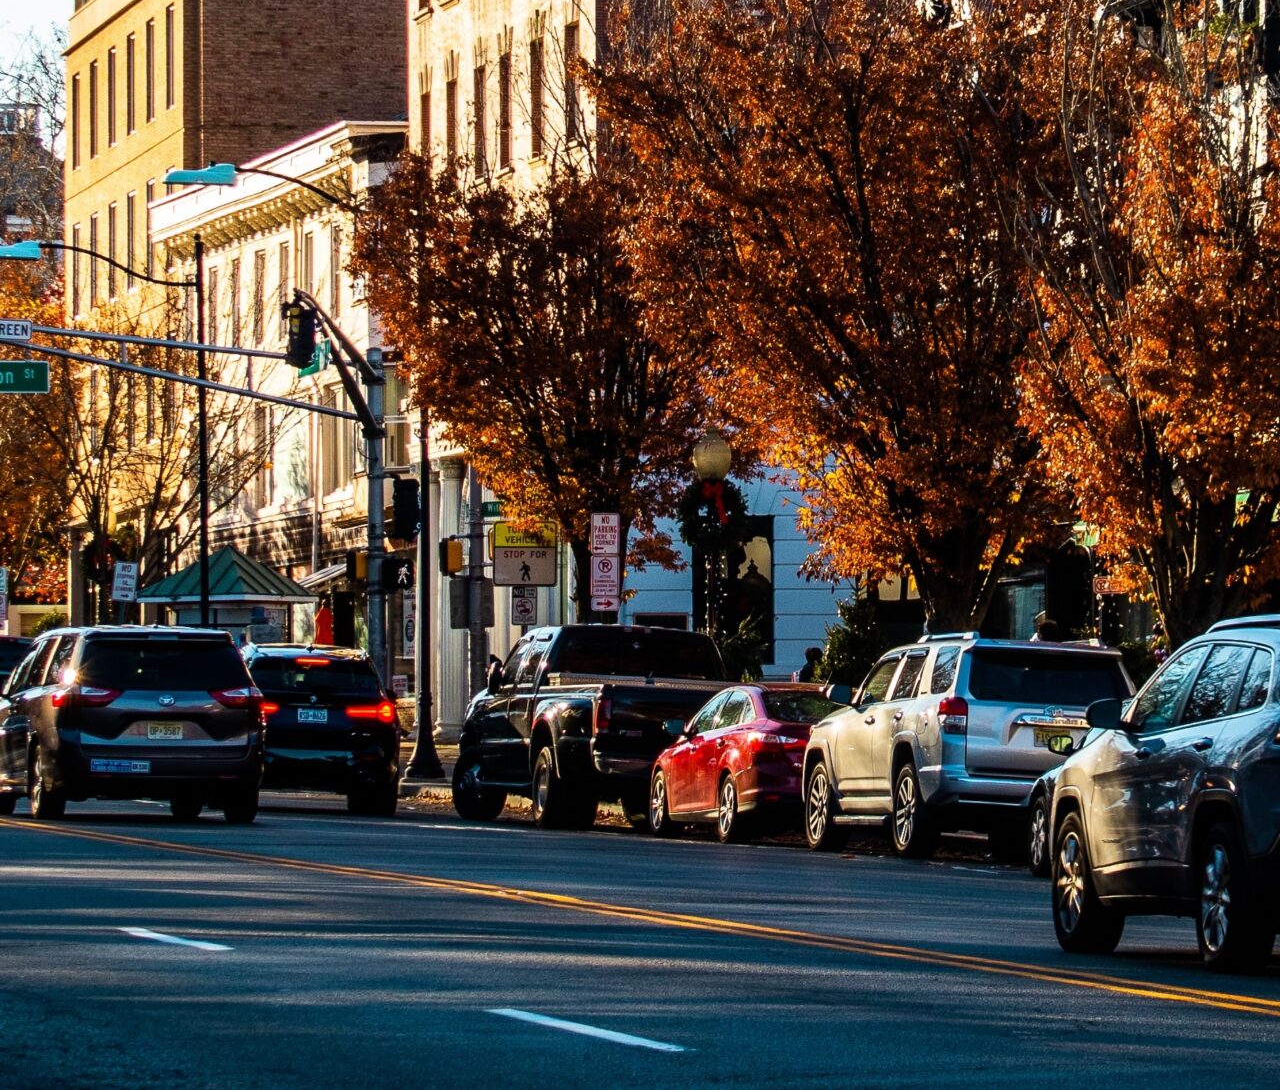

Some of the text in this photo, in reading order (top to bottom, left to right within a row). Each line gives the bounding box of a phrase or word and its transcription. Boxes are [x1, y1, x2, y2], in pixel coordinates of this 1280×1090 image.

[24, 368, 35, 379] St
[601, 516, 610, 524] NO
[503, 550, 547, 559] STOP FOR
[121, 564, 132, 573] NO
